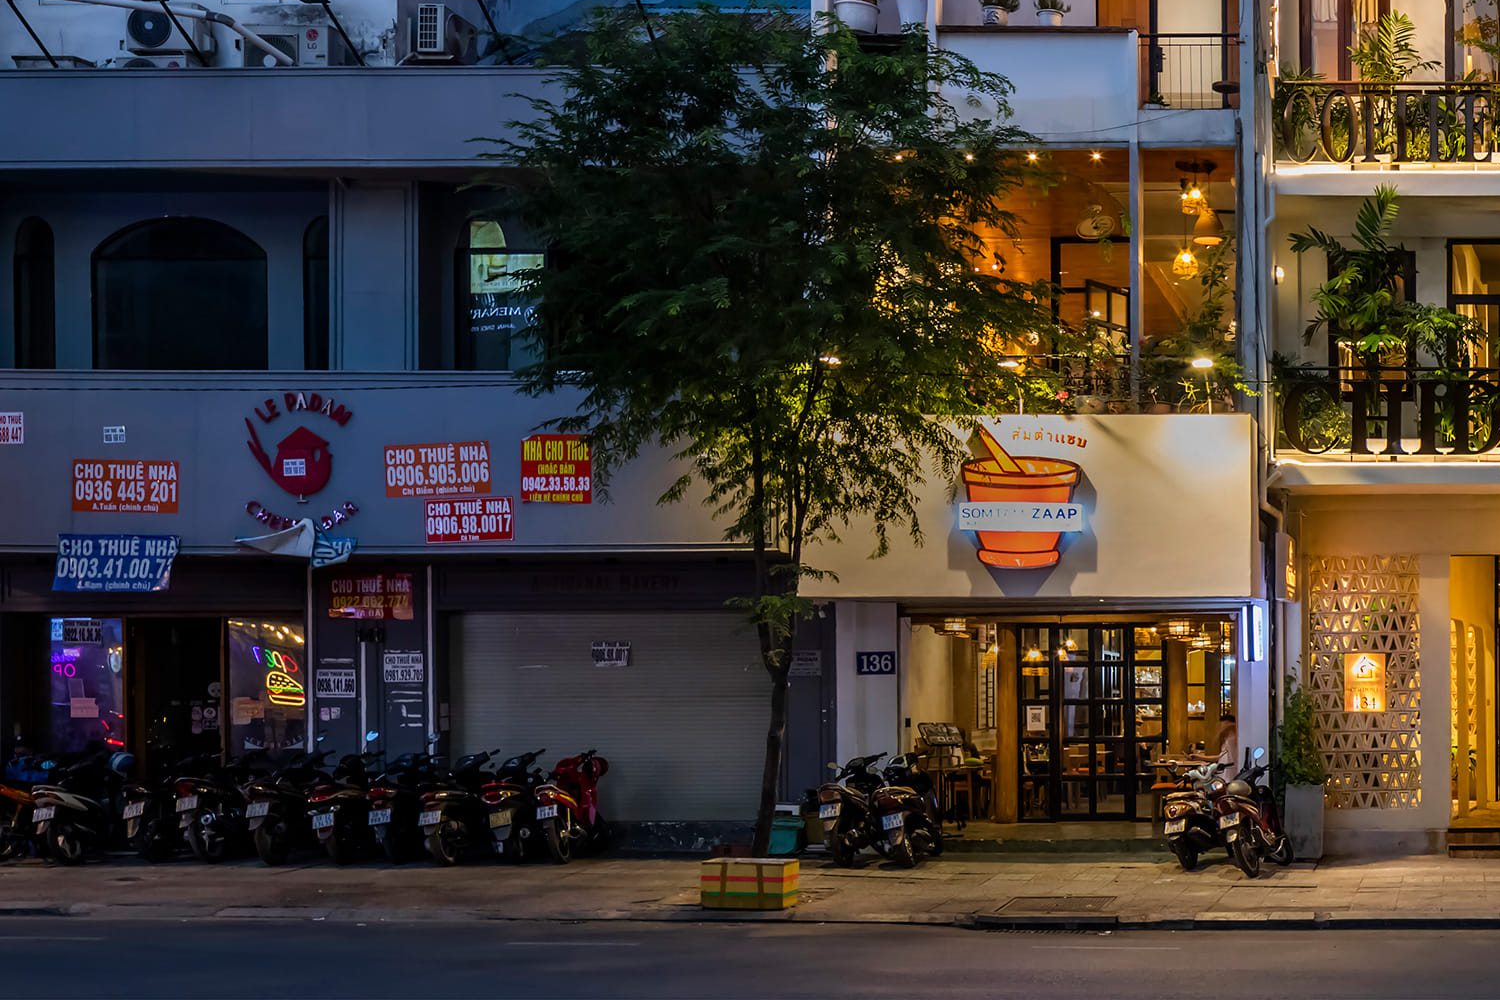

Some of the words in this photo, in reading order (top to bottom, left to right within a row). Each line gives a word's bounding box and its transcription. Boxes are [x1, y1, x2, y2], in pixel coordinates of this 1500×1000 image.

[254, 398, 281, 424] LE
[283, 391, 353, 427] PADAM
[386, 449, 415, 465] CHO
[419, 444, 455, 463] THUÊ
[460, 442, 488, 461] NHÀ
[523, 437, 543, 461] NHÀ
[545, 440, 563, 461] CHO
[75, 463, 103, 479] CHO
[108, 461, 144, 480] THUÊ
[148, 462, 177, 480] NHÀ
[387, 462, 489, 486] 0906.905.006
[75, 480, 112, 501] 0936
[117, 480, 145, 502] 445
[150, 481, 177, 503] 201
[522, 476, 590, 492] 0942.33.58.33
[427, 502, 450, 516] CHO
[453, 499, 483, 515] THUÊ
[486, 497, 510, 513] NHÀ
[1032, 508, 1078, 519] ZAAP
[427, 514, 511, 535] 0906.98.0017
[59, 539, 93, 556] CHO
[99, 536, 140, 556] THUÊ
[145, 537, 178, 556] NHÀ
[331, 579, 353, 593] CHO
[356, 574, 383, 593] THUÊ
[386, 577, 409, 593] NHÀ
[860, 654, 892, 673] 136
